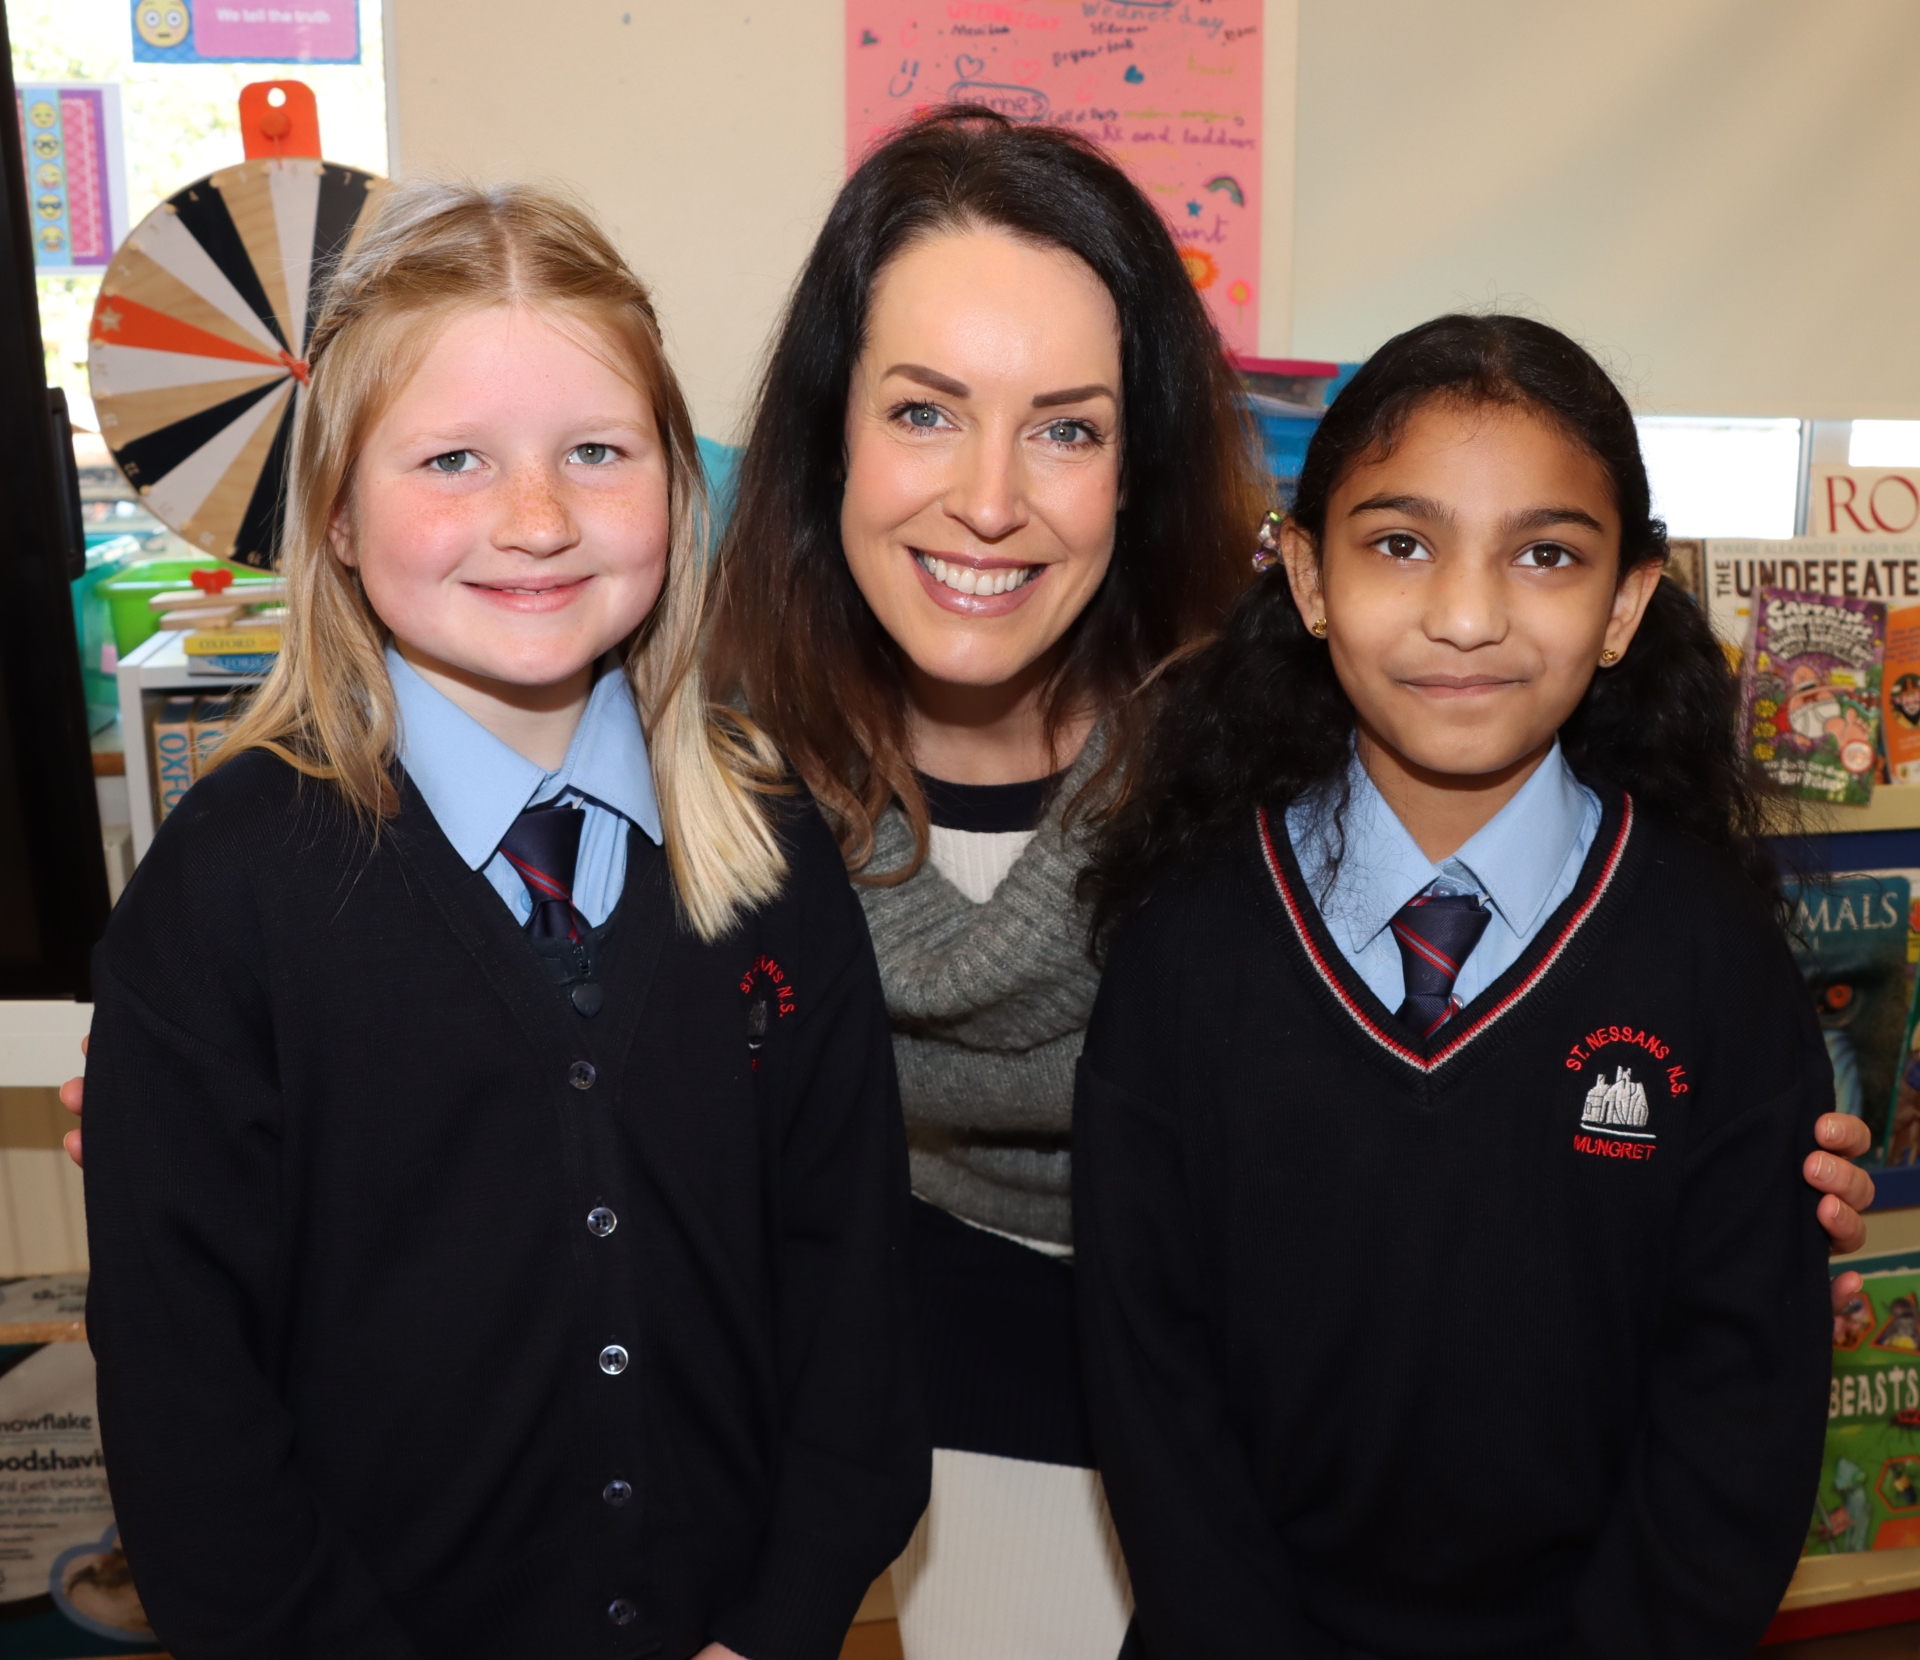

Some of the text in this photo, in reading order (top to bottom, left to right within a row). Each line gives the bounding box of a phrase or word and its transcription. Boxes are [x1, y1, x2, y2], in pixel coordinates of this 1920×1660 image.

[215, 8, 240, 22] We
[268, 9, 292, 23] the
[294, 9, 331, 24] truth
[1826, 474, 1920, 534] RO
[1715, 560, 1731, 598] THE
[1734, 559, 1920, 598] UNDEFEATE
[158, 733, 191, 817] OXFO
[1566, 1045, 1590, 1070] ST.
[1585, 1025, 1670, 1060] NESSANS
[1573, 1134, 1657, 1161] MUNGRET
[1828, 1365, 1919, 1419] BEASTS
[0, 1447, 105, 1472] odshavi
